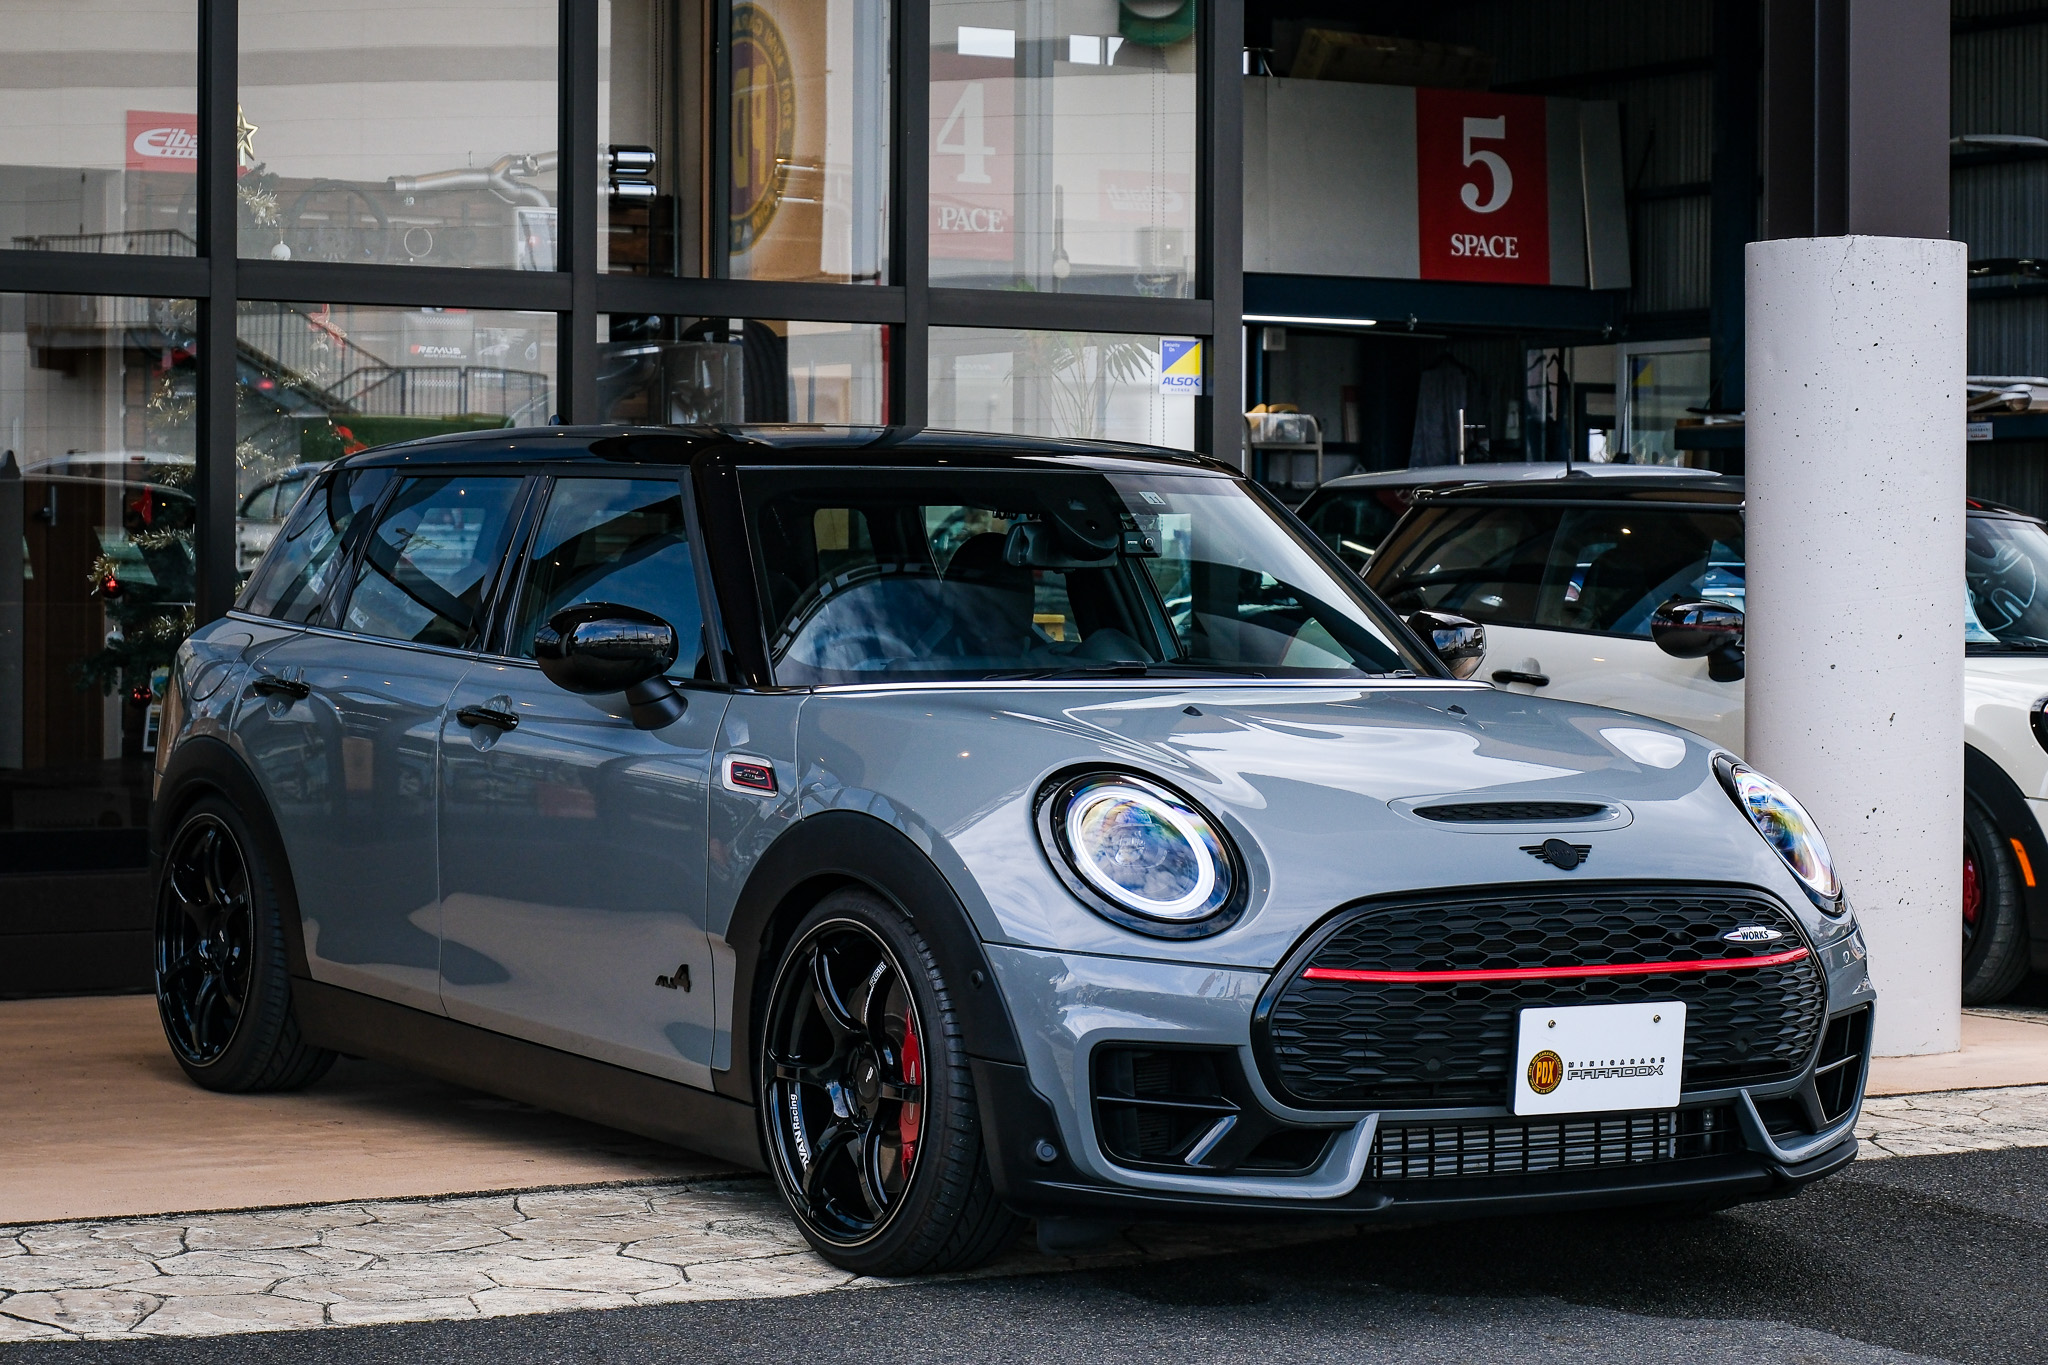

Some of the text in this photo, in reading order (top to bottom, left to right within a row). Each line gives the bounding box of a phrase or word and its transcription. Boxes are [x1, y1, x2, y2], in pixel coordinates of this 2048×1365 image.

[936, 82, 996, 184] 4
[1460, 115, 1513, 213] 5
[938, 206, 1004, 233] PACE
[1450, 233, 1519, 258] SPACE
[418, 345, 461, 355] REMUS
[1740, 930, 1769, 941] WORKS
[1535, 1060, 1555, 1084] PDX
[1567, 1065, 1664, 1080] PARADOX
[790, 1093, 801, 1130] Racing
